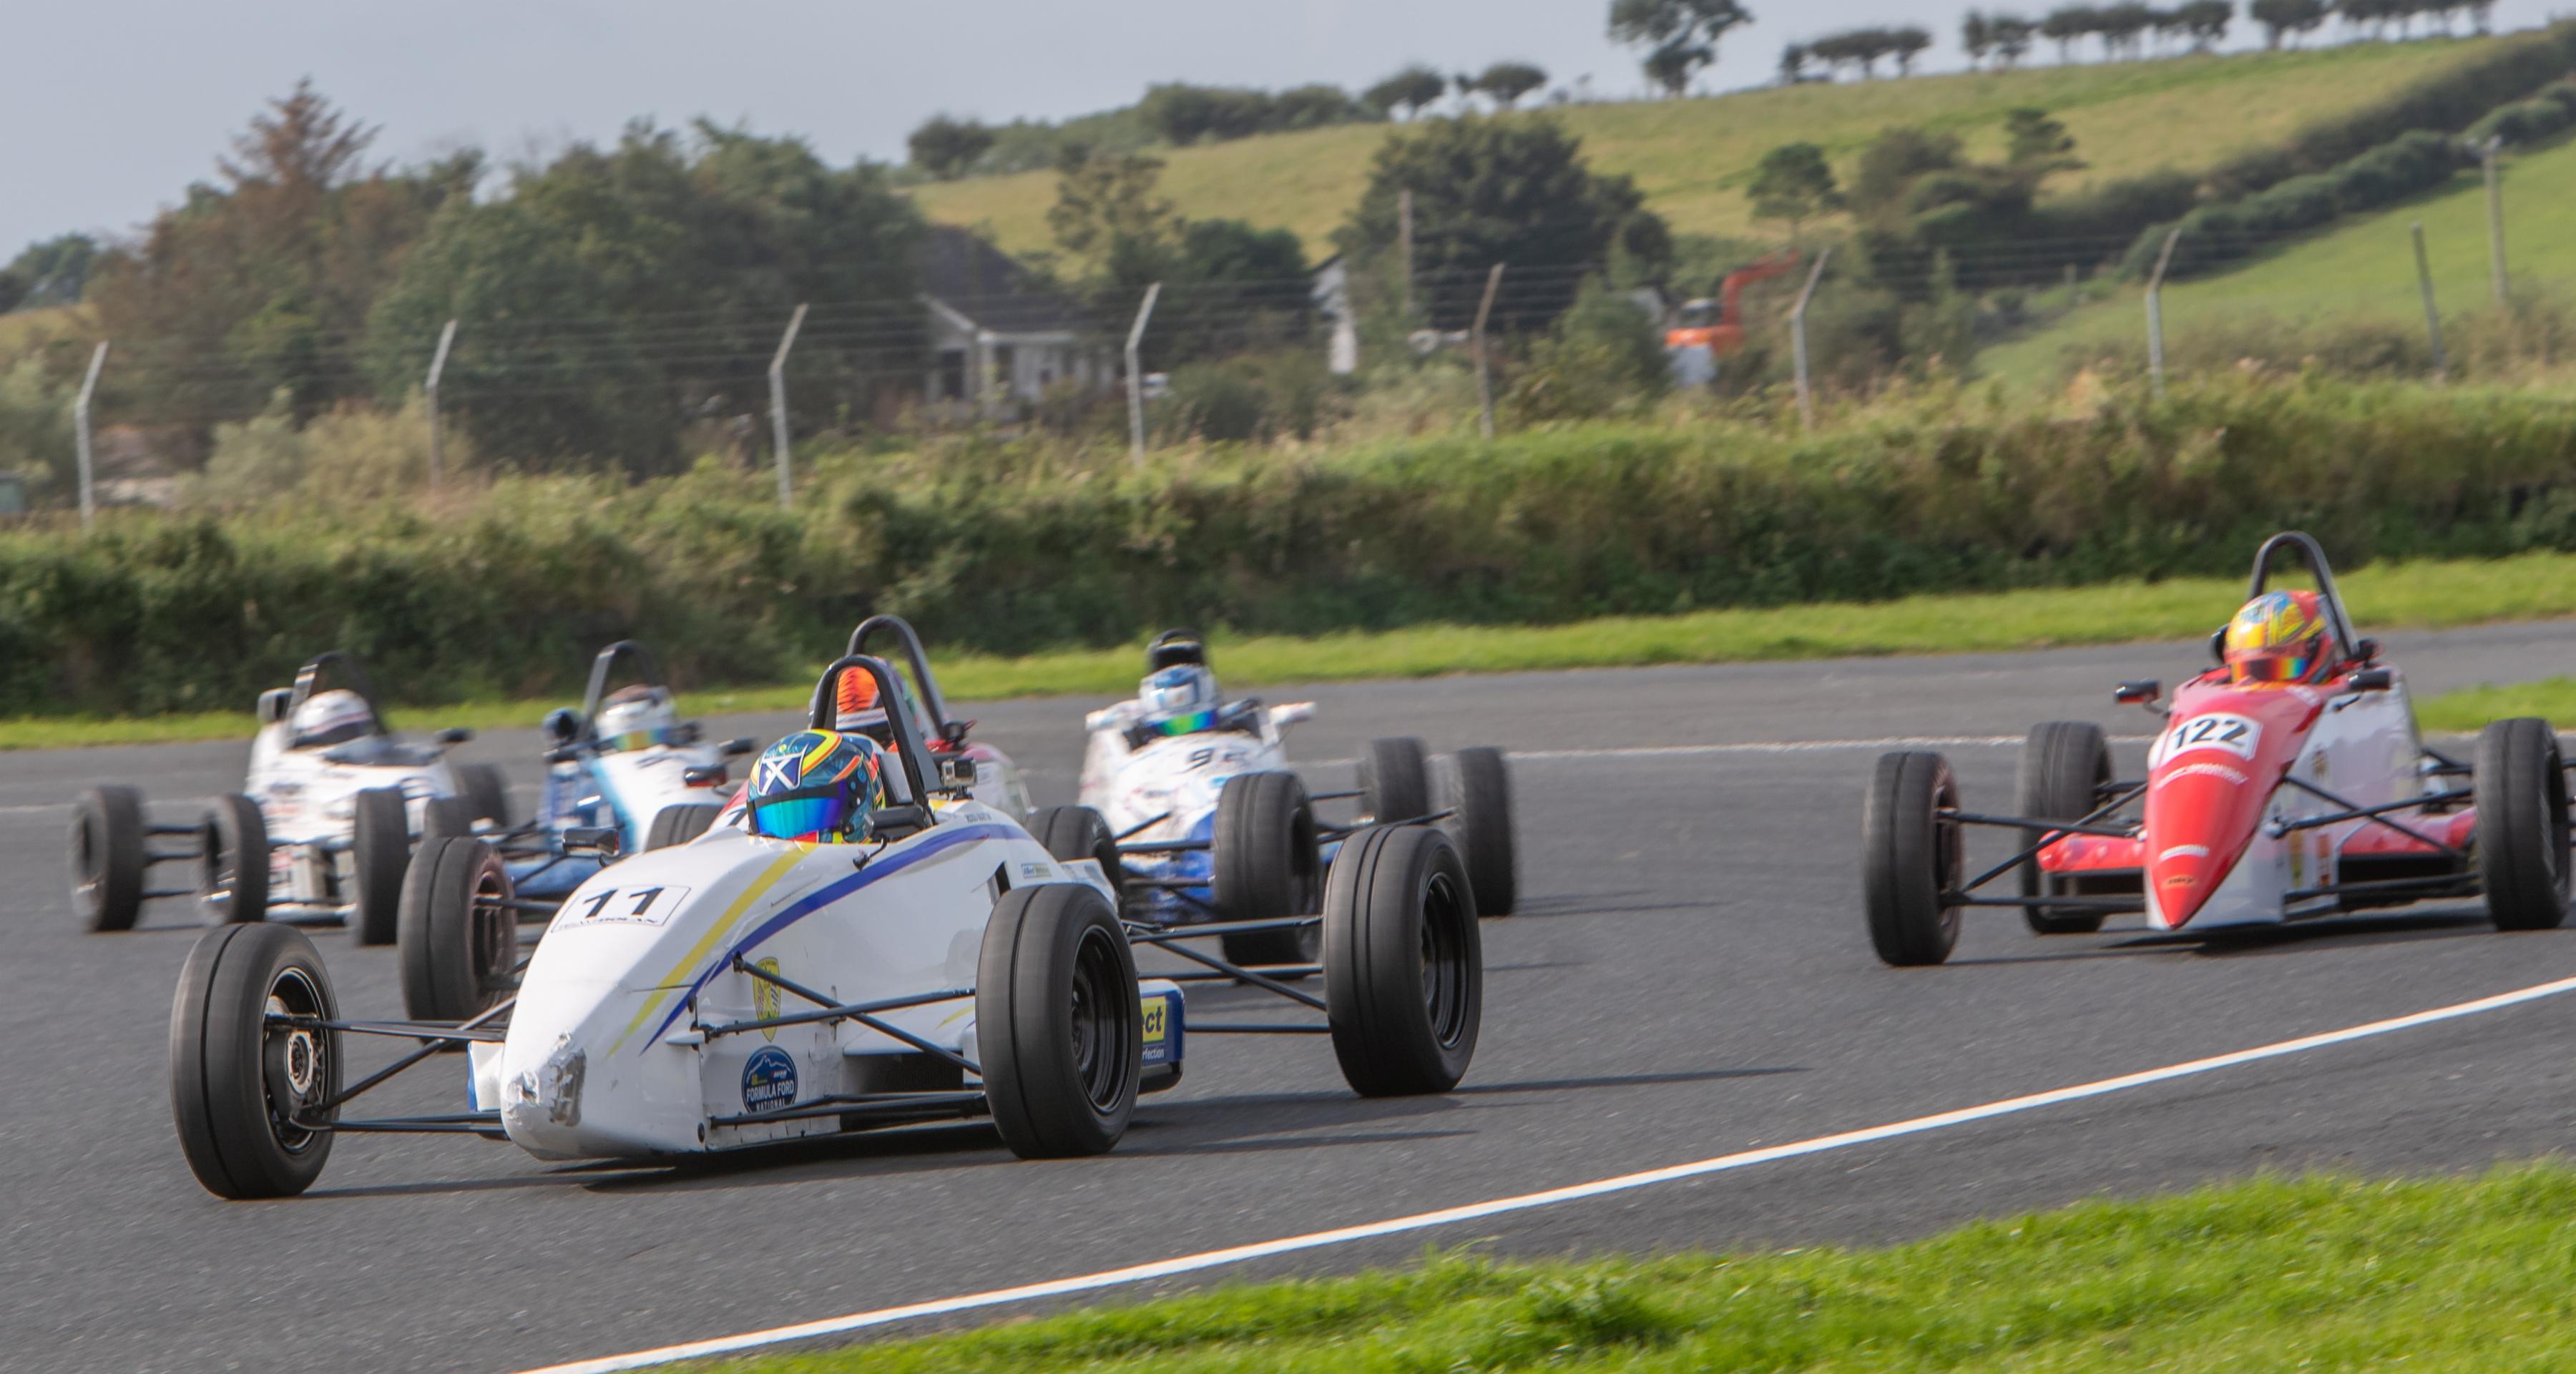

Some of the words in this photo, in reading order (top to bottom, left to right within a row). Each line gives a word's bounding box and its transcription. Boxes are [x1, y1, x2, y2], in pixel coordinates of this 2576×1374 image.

[2174, 718, 2247, 748] 122
[583, 887, 665, 918] 11
[1142, 1006, 1162, 1033] ct
[747, 1083, 776, 1102] FORMULA
[778, 1080, 794, 1096] FORD
[755, 1098, 786, 1111] NATIONAL
